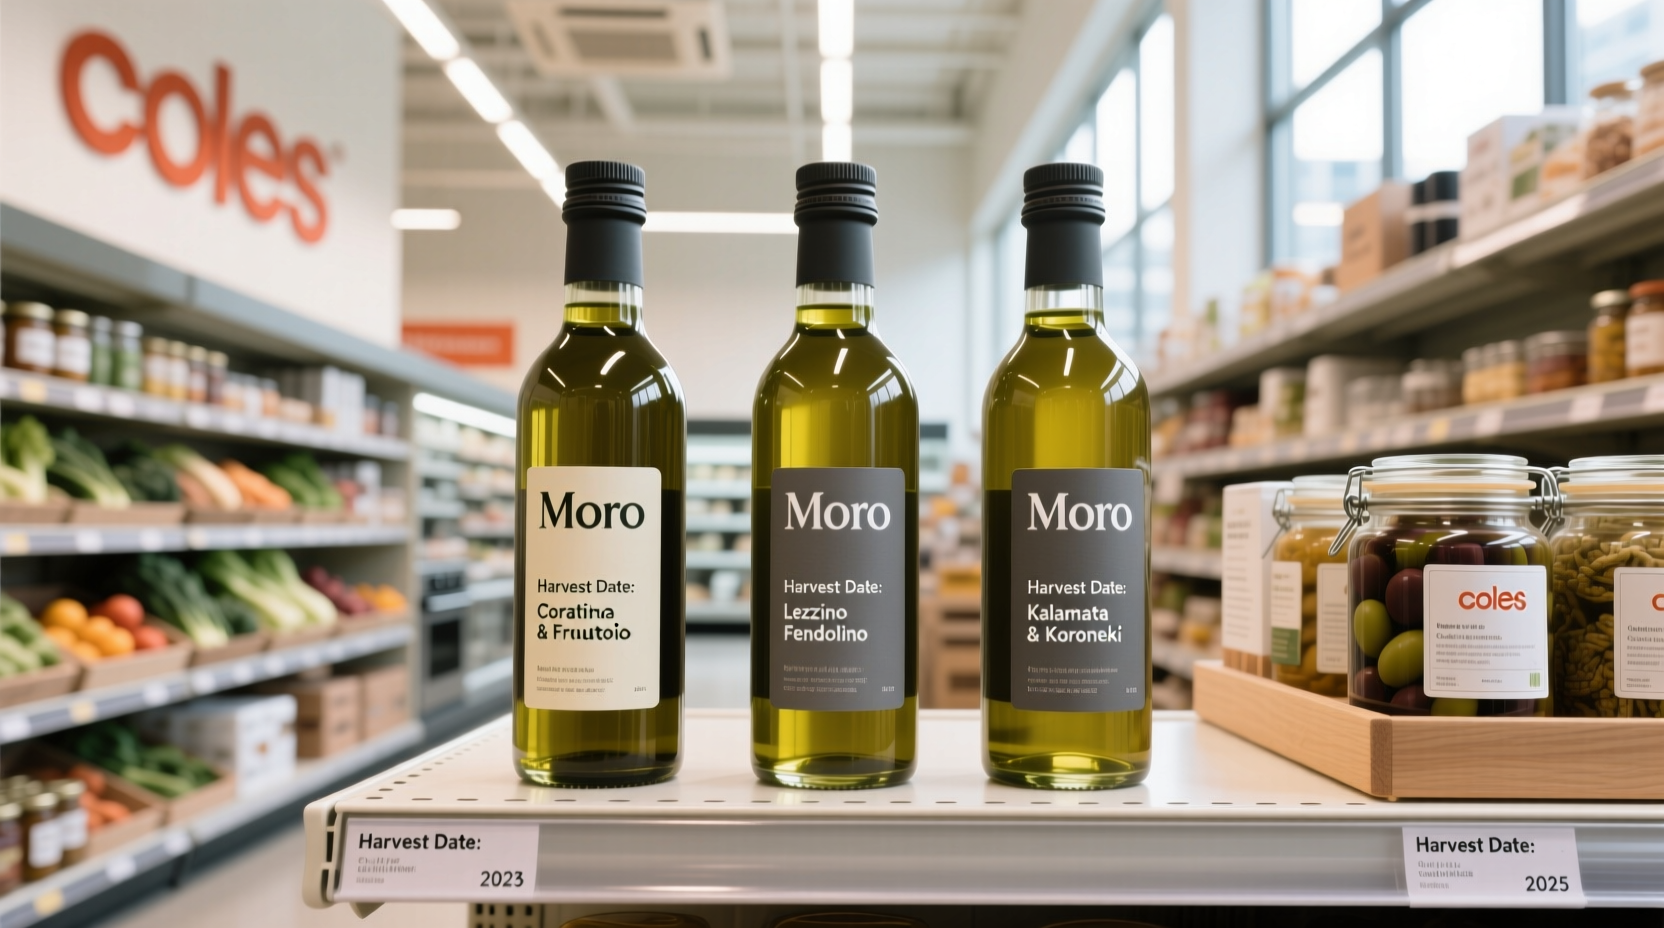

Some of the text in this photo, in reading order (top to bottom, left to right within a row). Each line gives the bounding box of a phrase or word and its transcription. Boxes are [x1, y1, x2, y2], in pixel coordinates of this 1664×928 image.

[58, 29, 330, 244] coles
[539, 491, 645, 530] Moro
[784, 491, 891, 531] Moro
[1027, 492, 1133, 531] Moro
[537, 578, 635, 594] Harvest Date:
[784, 579, 883, 594] Harvest Date:
[1027, 579, 1127, 595] Harvest Date:
[1458, 585, 1527, 611] coles
[784, 603, 848, 621] Lezzino
[1027, 603, 1109, 621] Kalamata
[537, 623, 548, 640] &
[784, 624, 869, 642] Fendolino
[1026, 625, 1122, 643] & Koroneki
[358, 833, 481, 850] Harvest Date:
[1416, 836, 1535, 854] Harvest Date:
[480, 870, 524, 888] 2023
[1525, 875, 1570, 892] 2025
